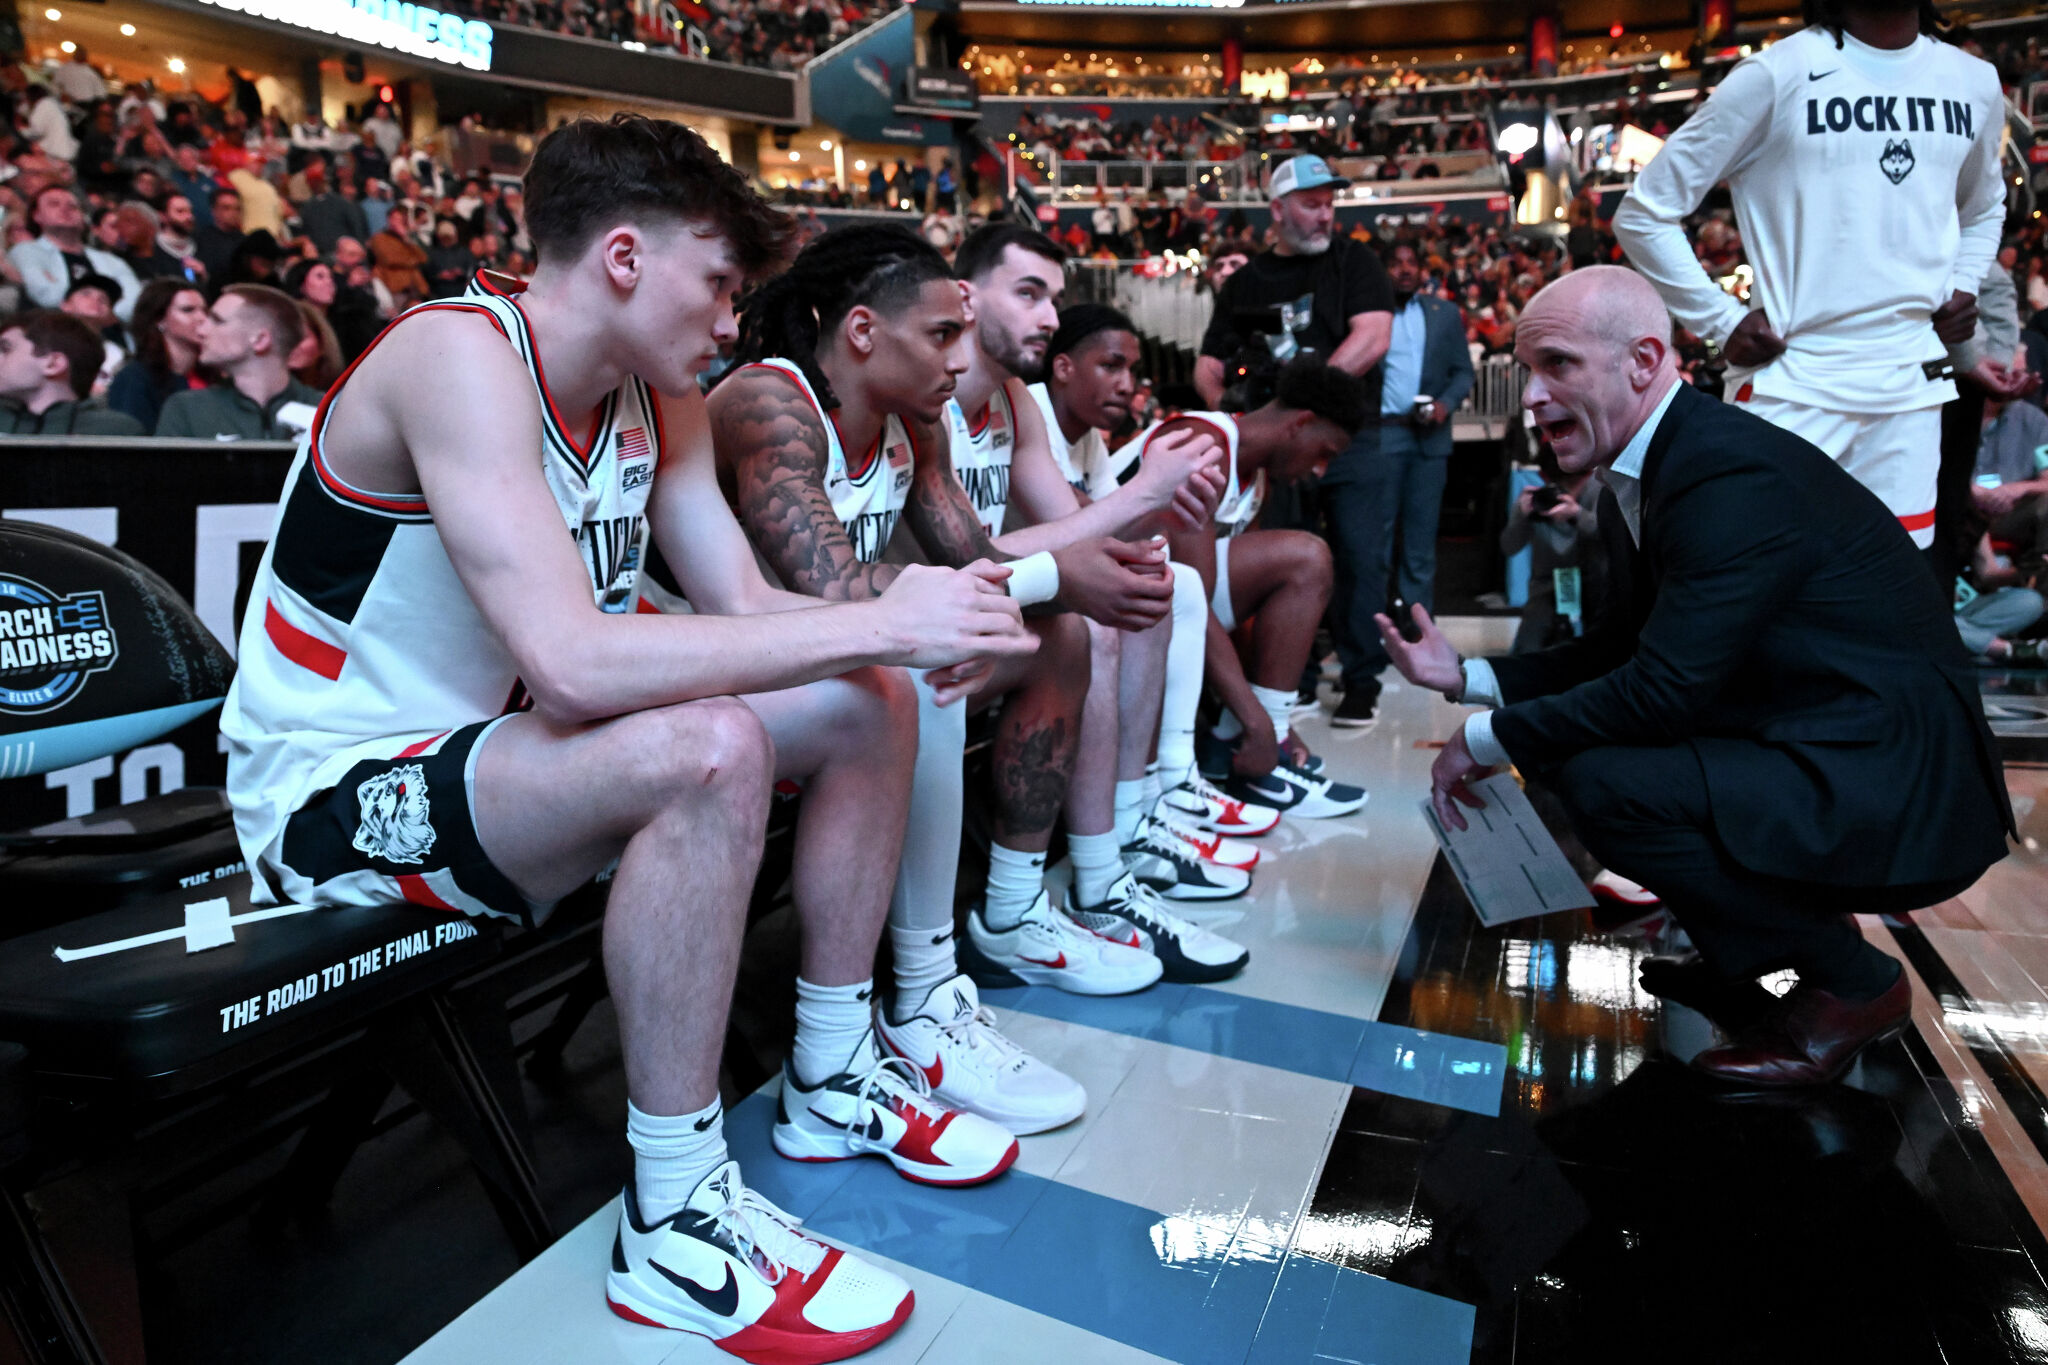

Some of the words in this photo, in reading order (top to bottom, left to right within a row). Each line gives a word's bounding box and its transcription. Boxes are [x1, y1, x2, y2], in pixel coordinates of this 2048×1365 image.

[1807, 95, 1901, 135] LOCK
[1906, 97, 1936, 131] IT
[1942, 99, 1975, 141] IN.
[624, 463, 648, 478] BIG
[0, 606, 54, 638] RCH
[0, 629, 112, 669] ADNESS
[220, 995, 262, 1033] THE
[266, 973, 318, 1016] ROAD
[321, 963, 345, 992] TO
[348, 948, 381, 981] THE
[385, 930, 432, 967] FINAL
